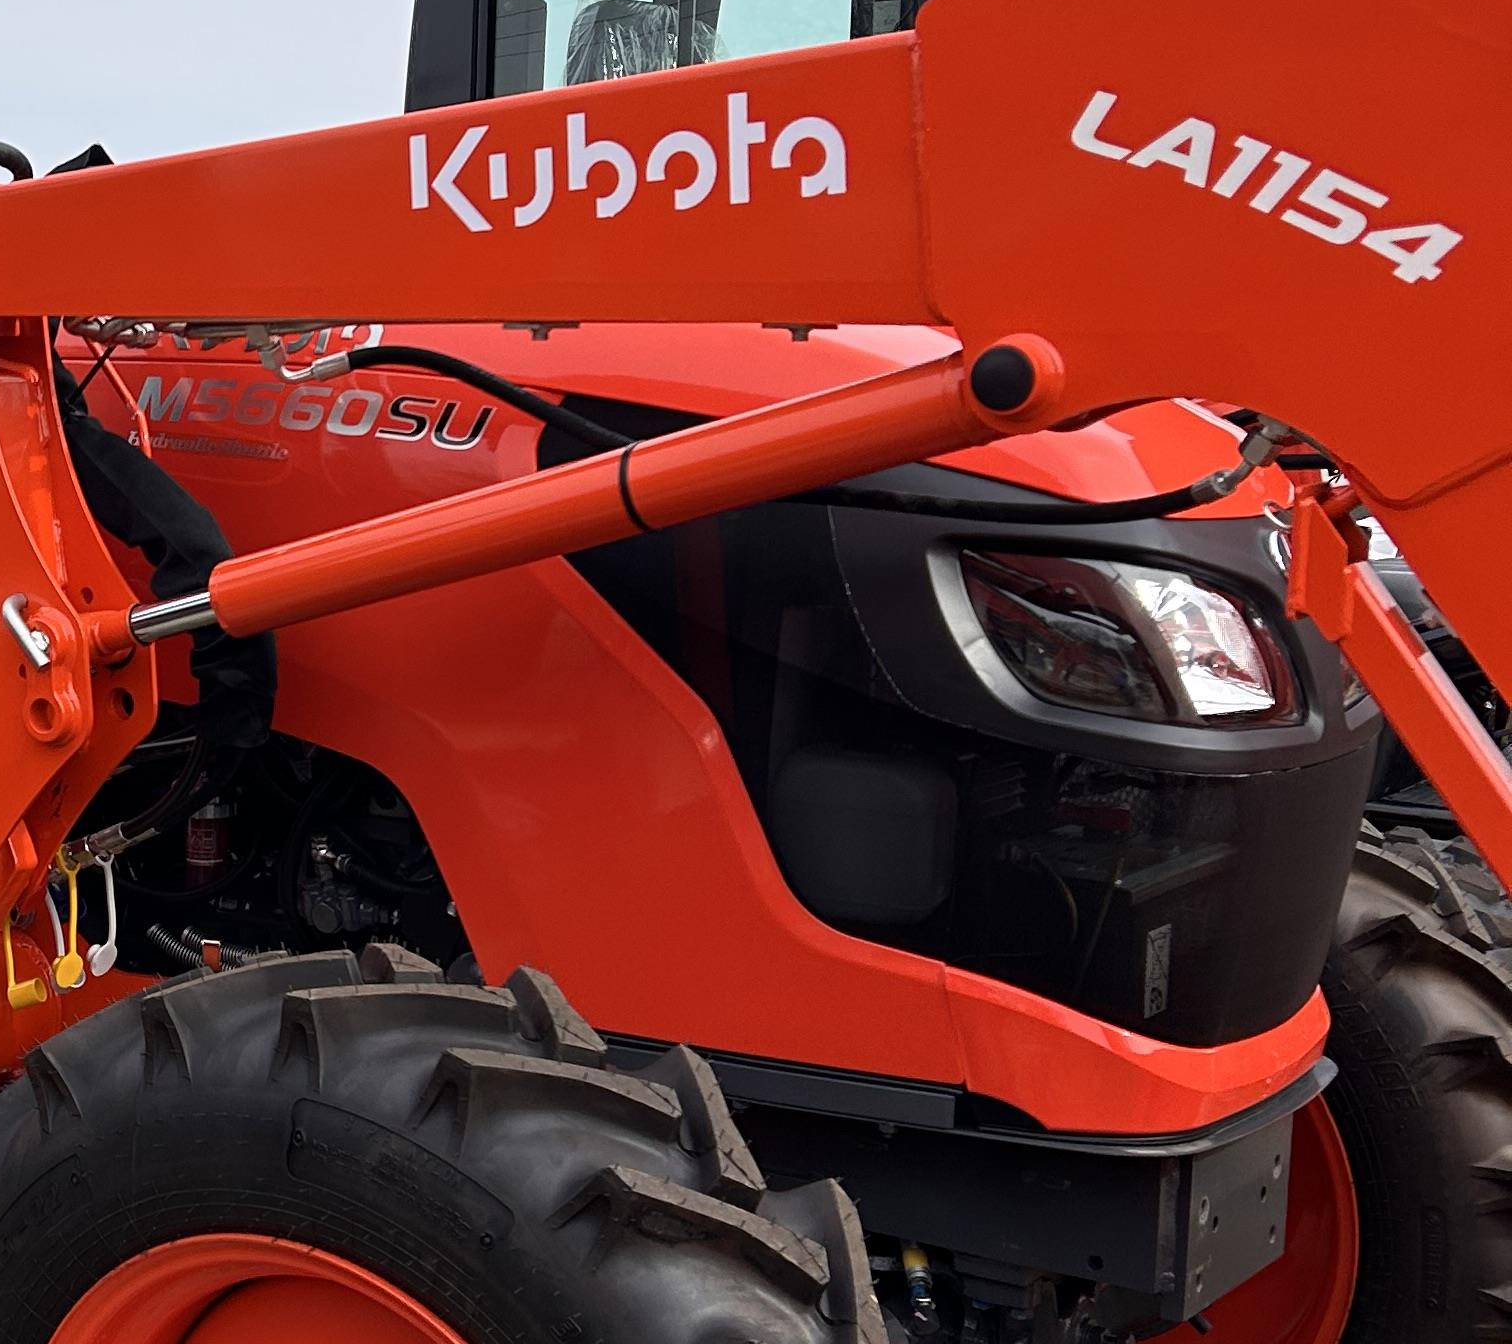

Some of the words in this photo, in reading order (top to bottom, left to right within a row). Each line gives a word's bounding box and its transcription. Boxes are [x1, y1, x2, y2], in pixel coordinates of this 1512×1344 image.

[408, 90, 848, 234] Kubota
[1070, 90, 1465, 285] LA1154
[135, 376, 496, 451] M5660SU
